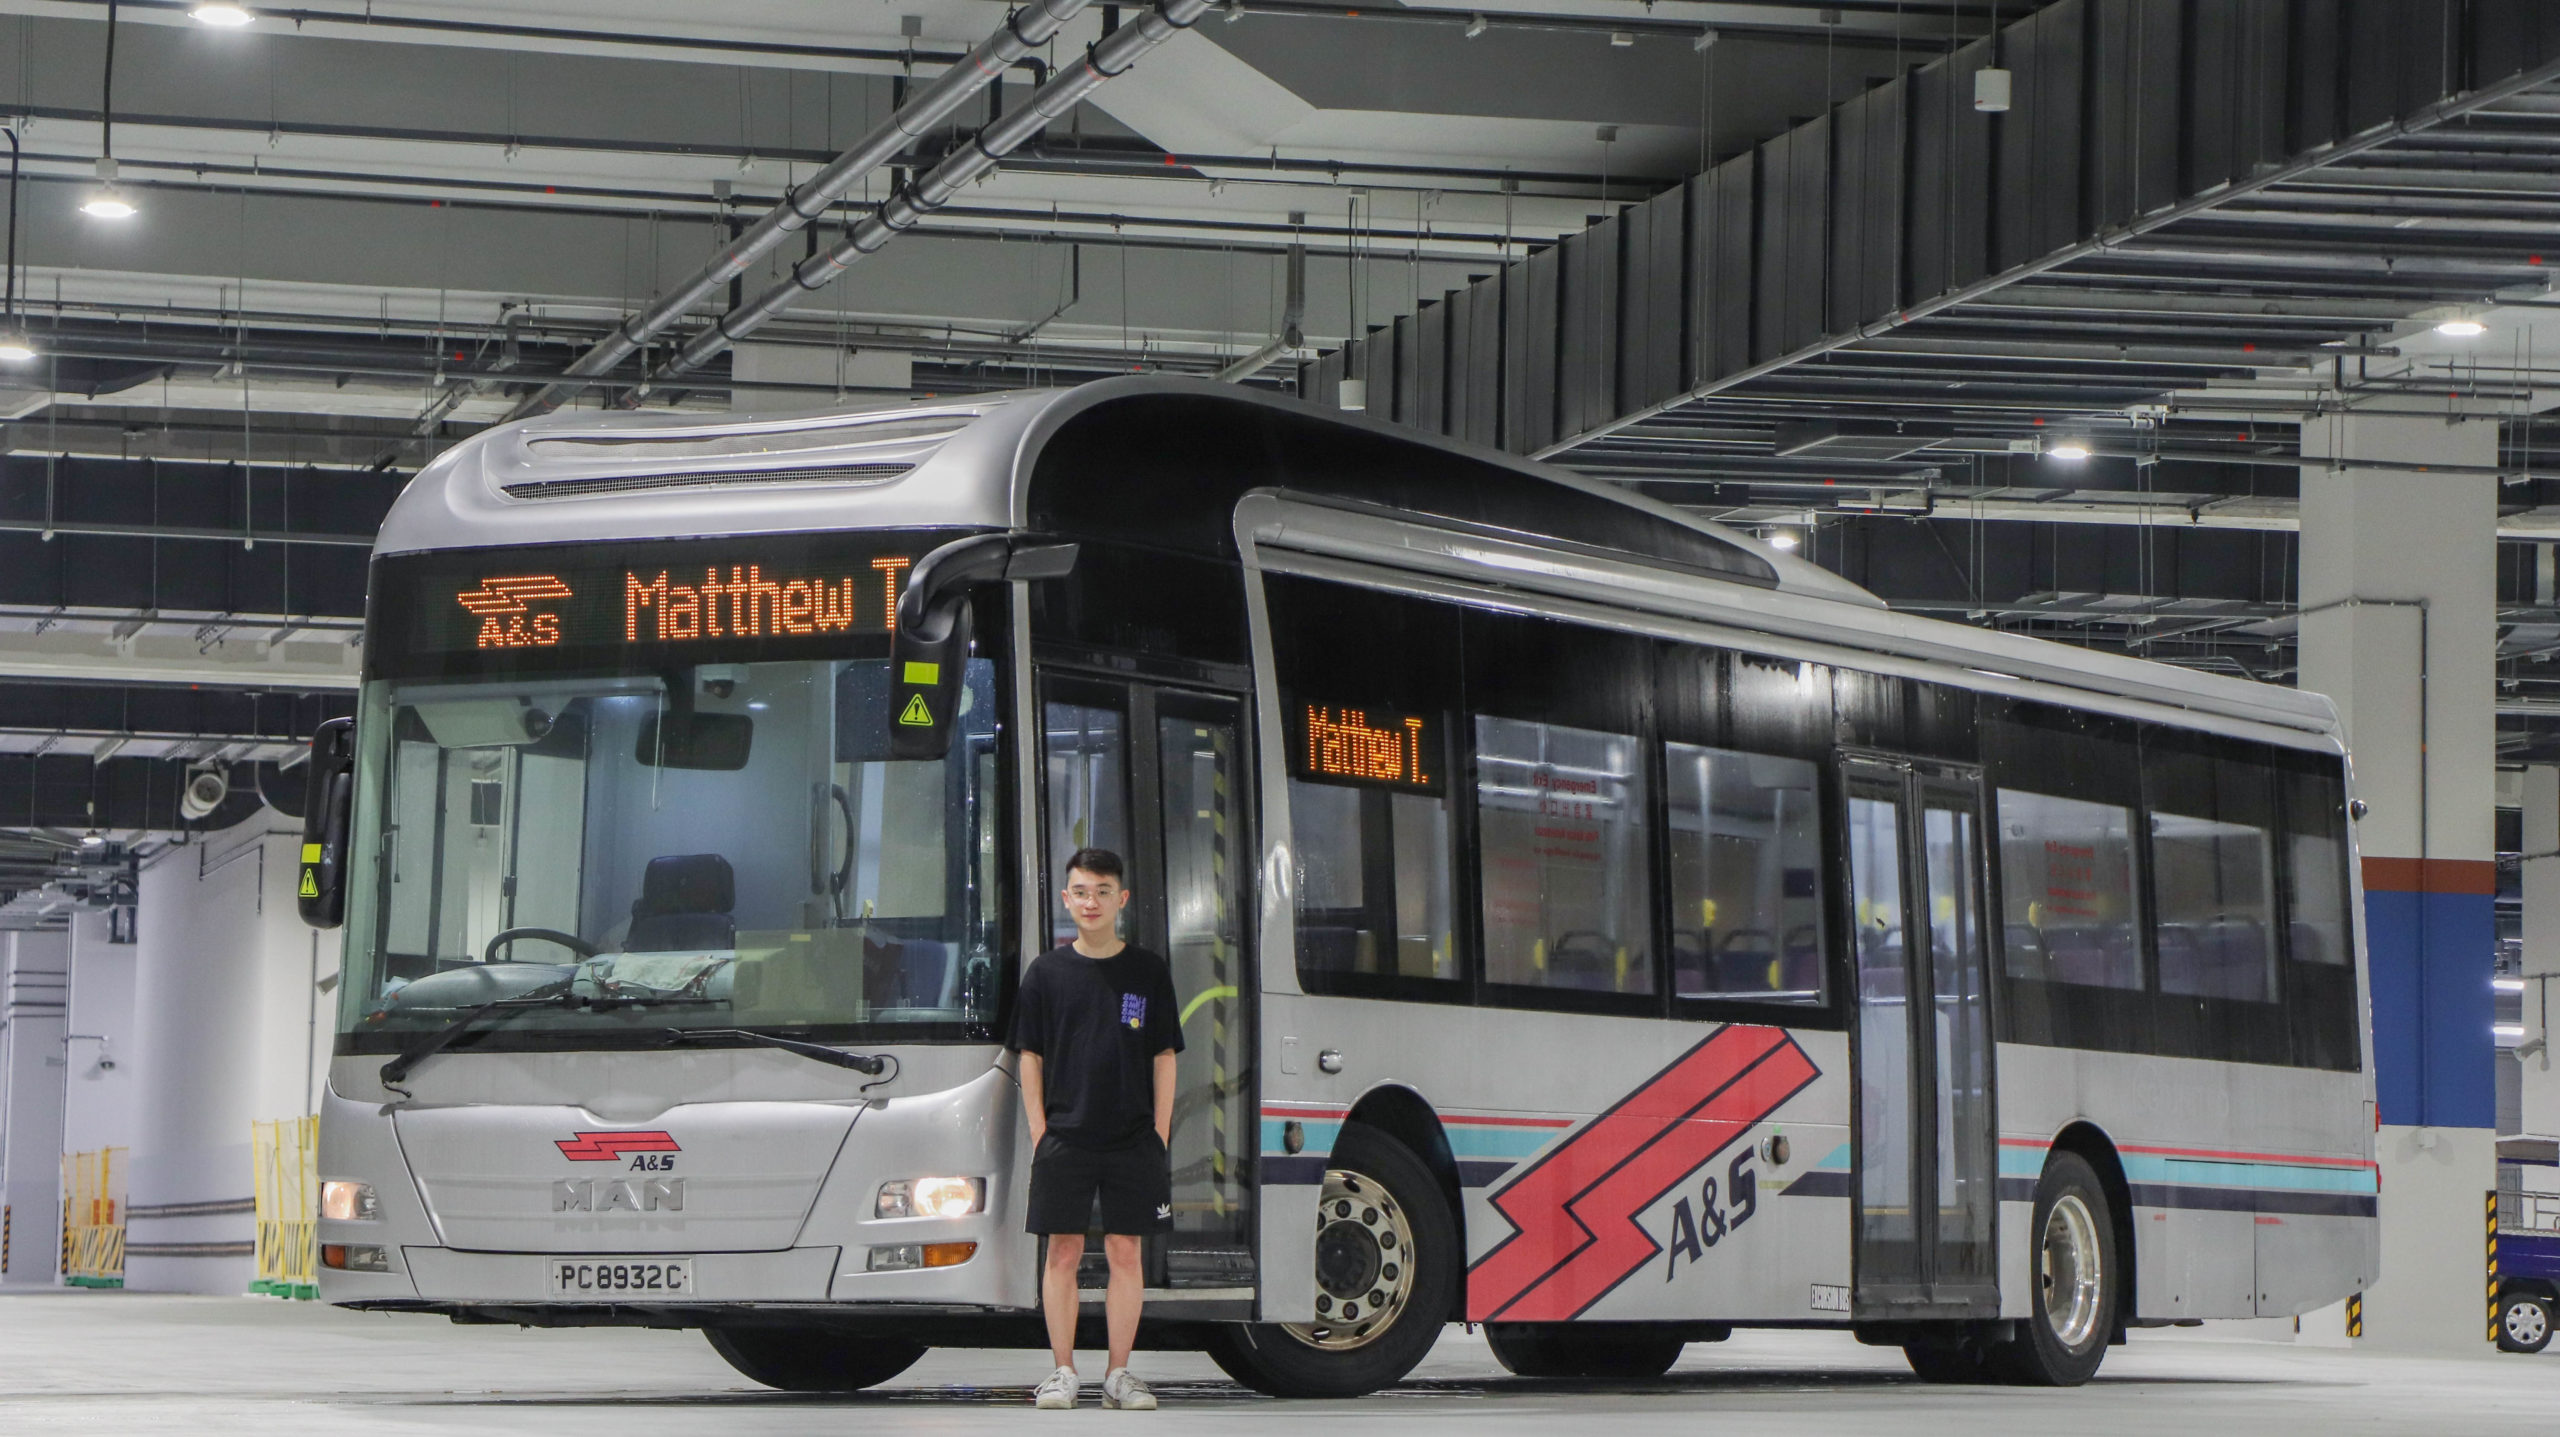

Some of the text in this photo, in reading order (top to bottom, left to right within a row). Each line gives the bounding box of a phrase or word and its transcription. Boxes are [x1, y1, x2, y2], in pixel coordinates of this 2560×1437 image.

[625, 564, 852, 641] Matthew
[478, 614, 560, 648] A&S
[1308, 704, 1429, 784] Matthew T.
[629, 1154, 675, 1171] A&S
[552, 1178, 686, 1212] MAN
[1667, 1144, 1757, 1284] A&S
[561, 1265, 682, 1290] PC8932C
